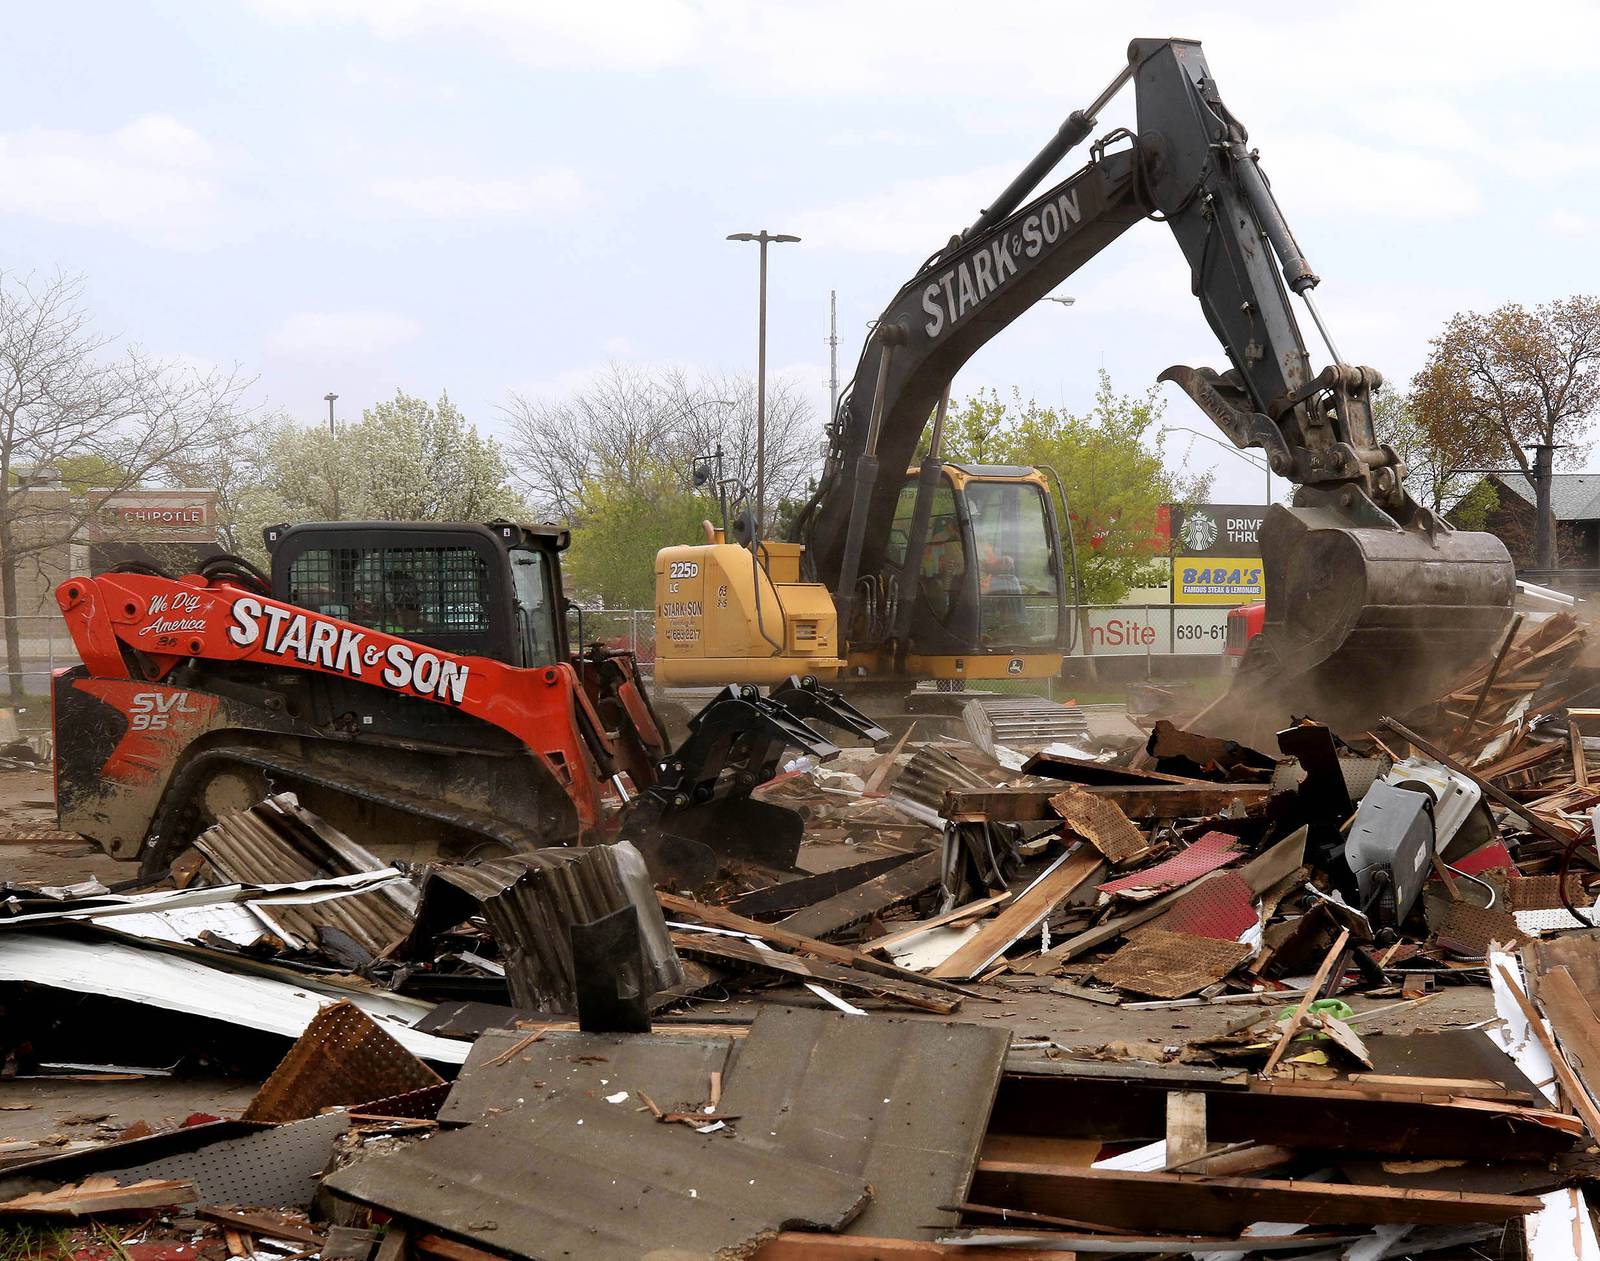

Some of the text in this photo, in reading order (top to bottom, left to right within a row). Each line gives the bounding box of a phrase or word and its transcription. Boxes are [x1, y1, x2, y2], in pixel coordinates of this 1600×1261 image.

[922, 231, 1018, 337] STARK
[1022, 188, 1081, 258] SON
[124, 511, 200, 522] CHIPOTLE
[670, 561, 699, 579] 225D
[1183, 568, 1262, 584] BABA'S
[669, 583, 679, 593] LC
[149, 592, 202, 615] We Dig
[139, 616, 206, 635] America
[1090, 620, 1156, 646] nSite
[1177, 624, 1228, 640] 630-61
[228, 597, 471, 704] STARK & SON
[128, 692, 198, 713] SVL
[129, 714, 170, 731] 95
